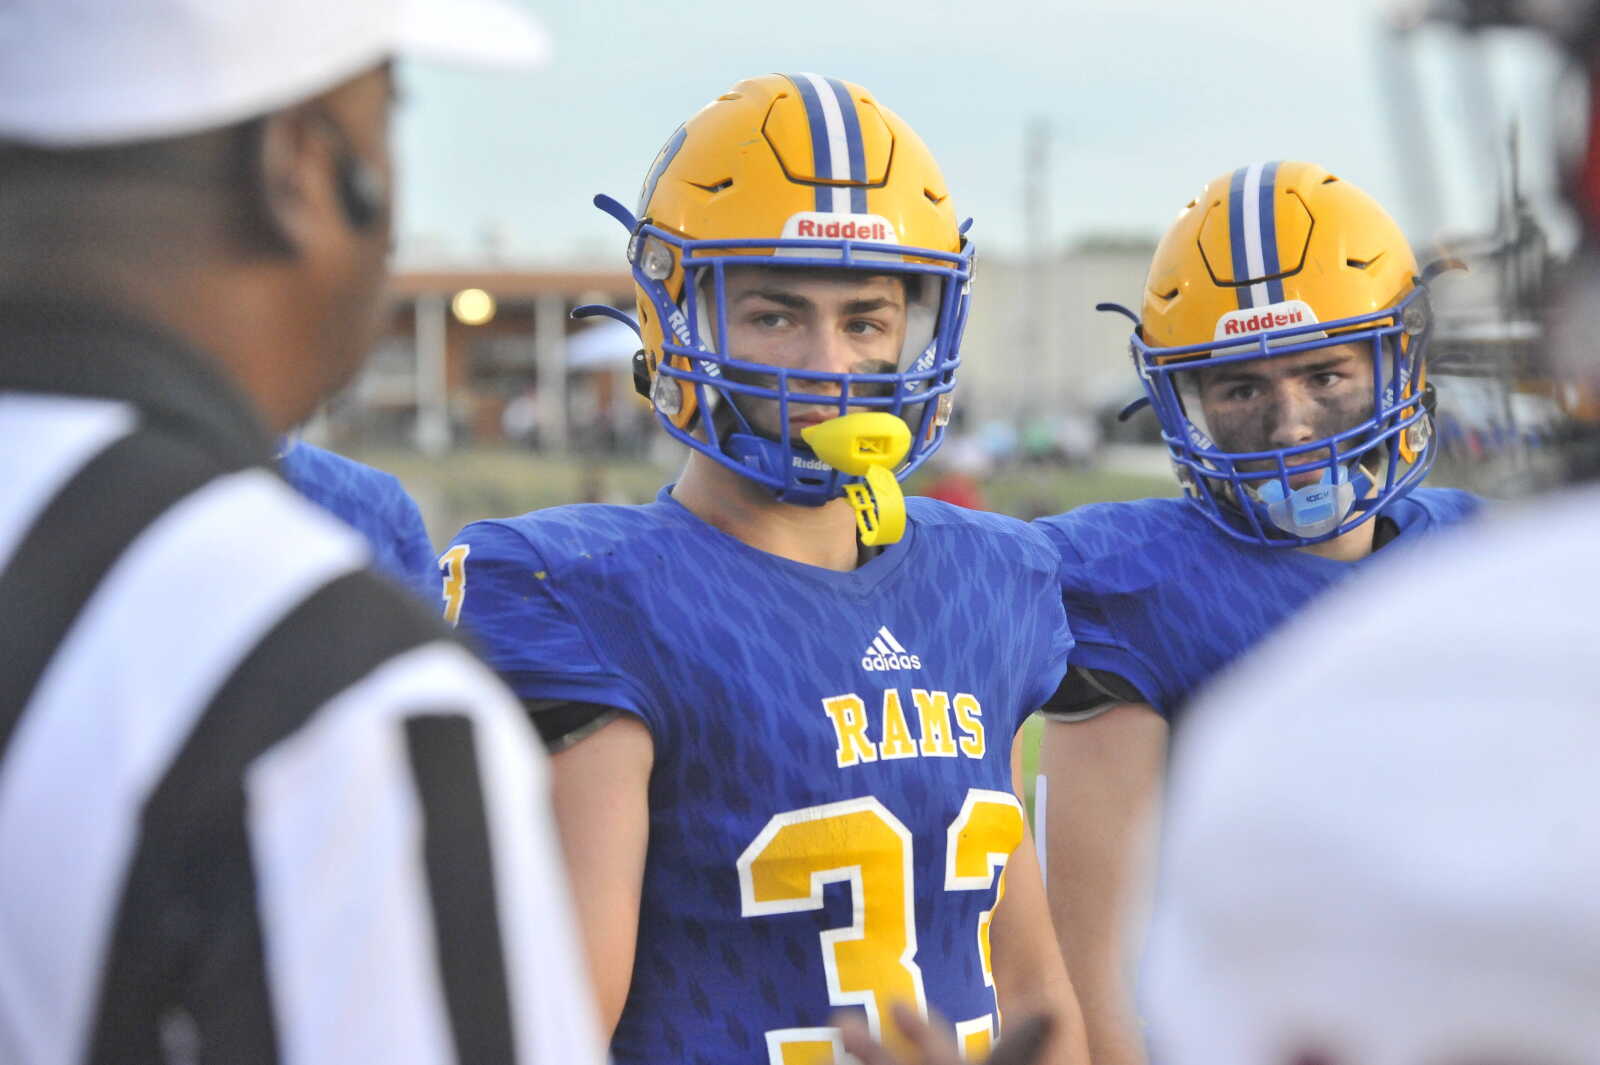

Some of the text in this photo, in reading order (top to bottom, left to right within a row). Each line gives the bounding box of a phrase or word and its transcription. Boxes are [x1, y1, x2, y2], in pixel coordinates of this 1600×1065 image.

[798, 219, 886, 240] Riddell
[1224, 310, 1304, 336] Riddell
[861, 652, 922, 671] adidas
[821, 688, 986, 768] RAMS
